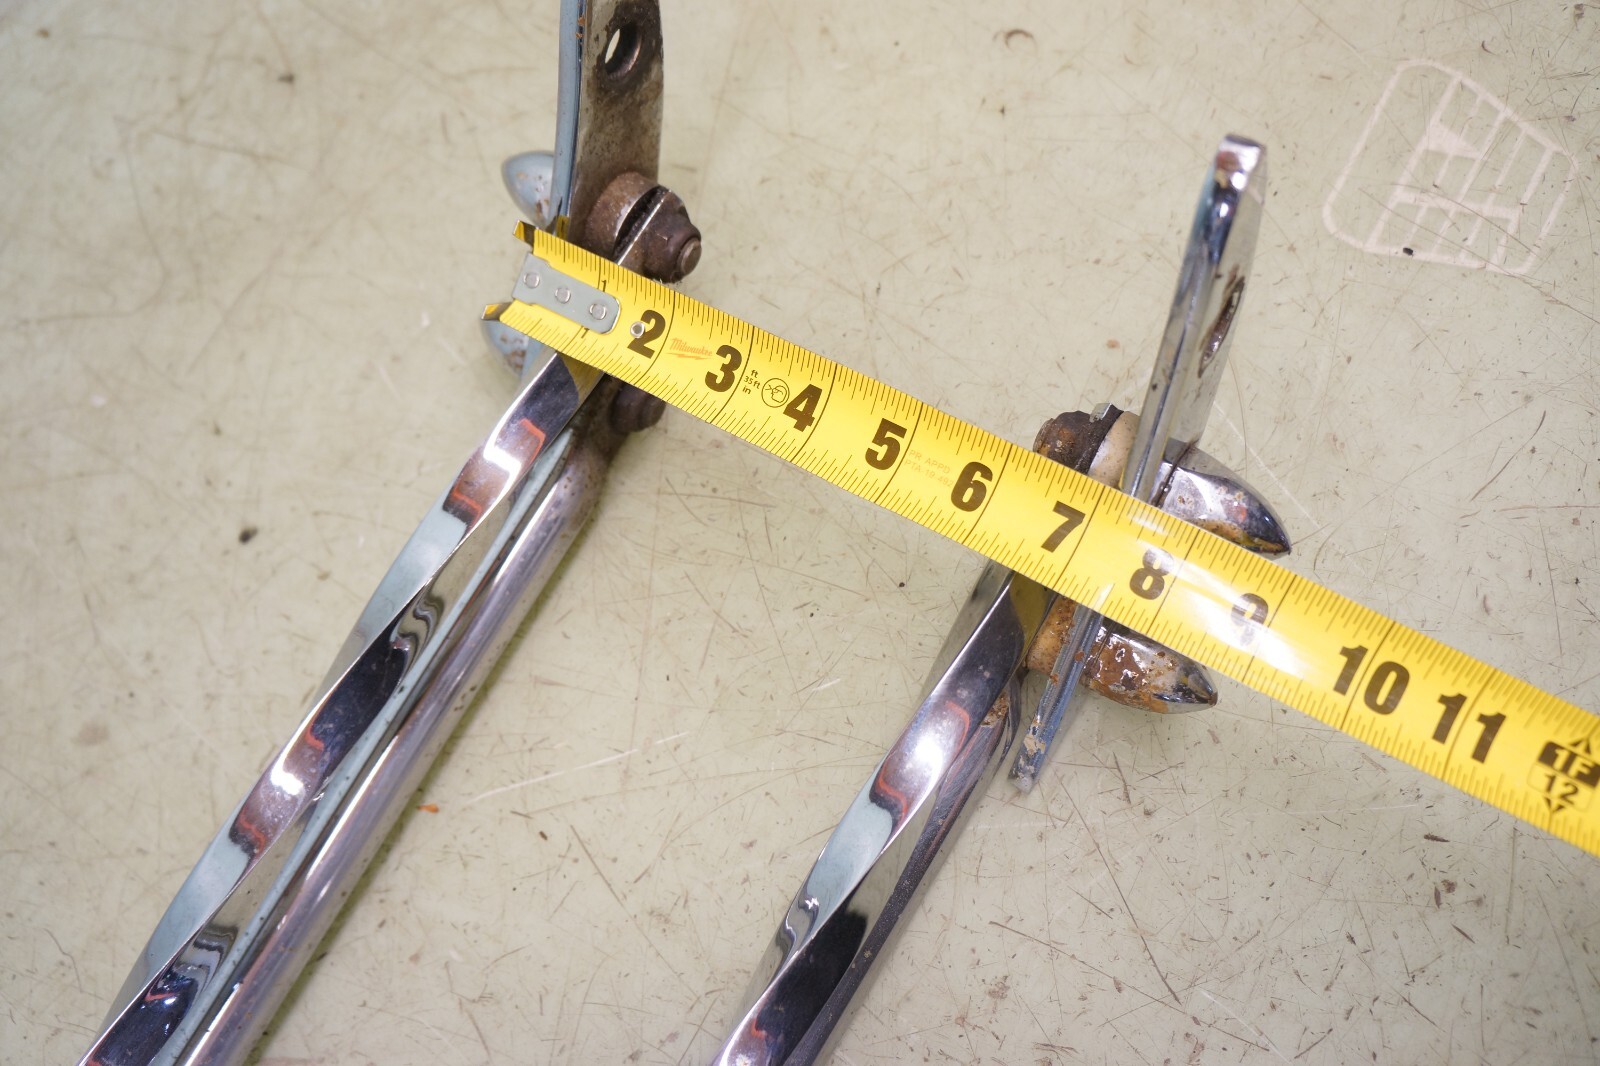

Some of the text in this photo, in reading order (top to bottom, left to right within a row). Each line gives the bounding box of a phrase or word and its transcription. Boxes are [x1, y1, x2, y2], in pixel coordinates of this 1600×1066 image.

[627, 310, 666, 359] 2
[670, 337, 713, 357] Milwaukee
[704, 345, 742, 392] 3
[742, 385, 751, 395] in
[743, 375, 761, 390] 35 ft
[751, 369, 758, 378] ft
[783, 384, 823, 432] 4
[865, 418, 907, 470] 5
[951, 461, 993, 512] 6
[1041, 501, 1086, 553] 7
[1129, 549, 1174, 600] 8
[1231, 593, 1269, 646] 9
[1333, 645, 1410, 715] 10
[1432, 693, 1507, 764] 11
[1545, 773, 1579, 806] 12
